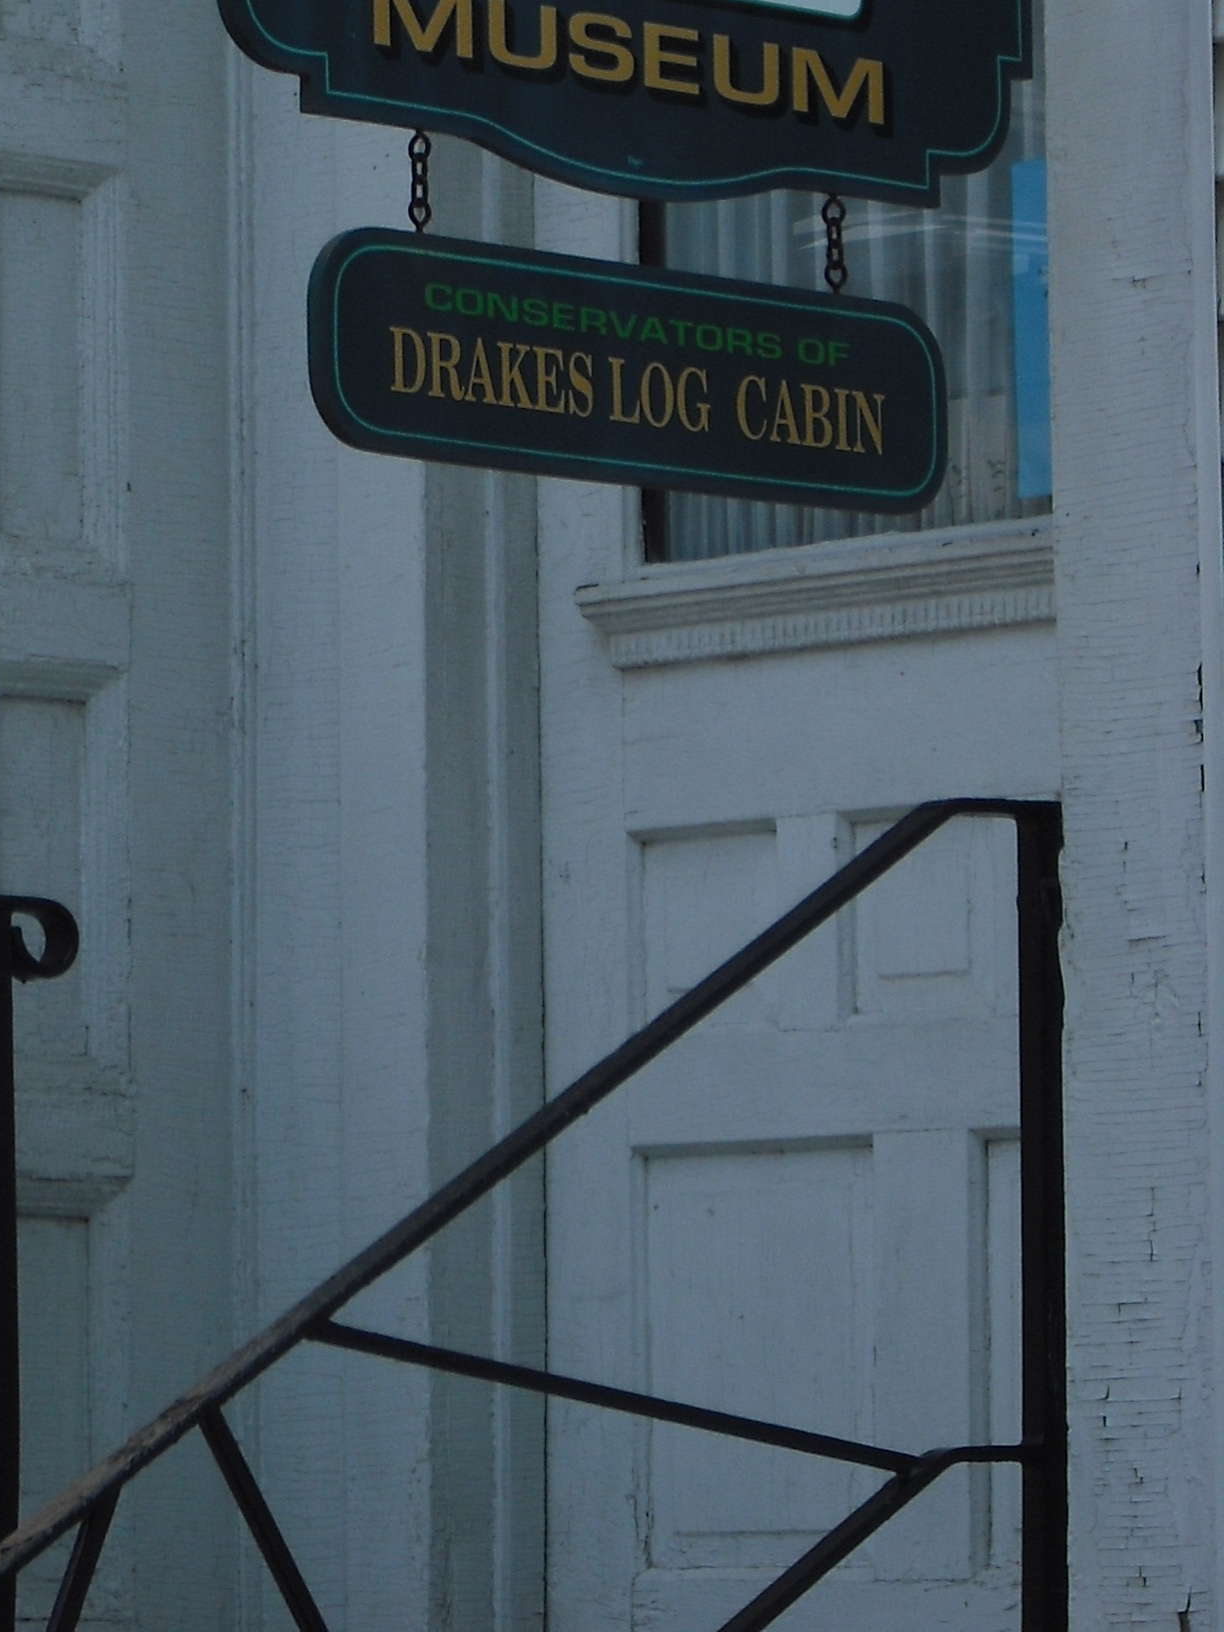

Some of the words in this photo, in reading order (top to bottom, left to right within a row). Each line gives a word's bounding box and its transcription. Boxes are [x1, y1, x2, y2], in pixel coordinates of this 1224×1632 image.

[424, 283, 783, 360] CONSERVATORS
[797, 337, 851, 366] OF
[389, 325, 595, 418] DRAKES
[608, 355, 711, 432] LOG
[736, 374, 886, 456] CABIN
